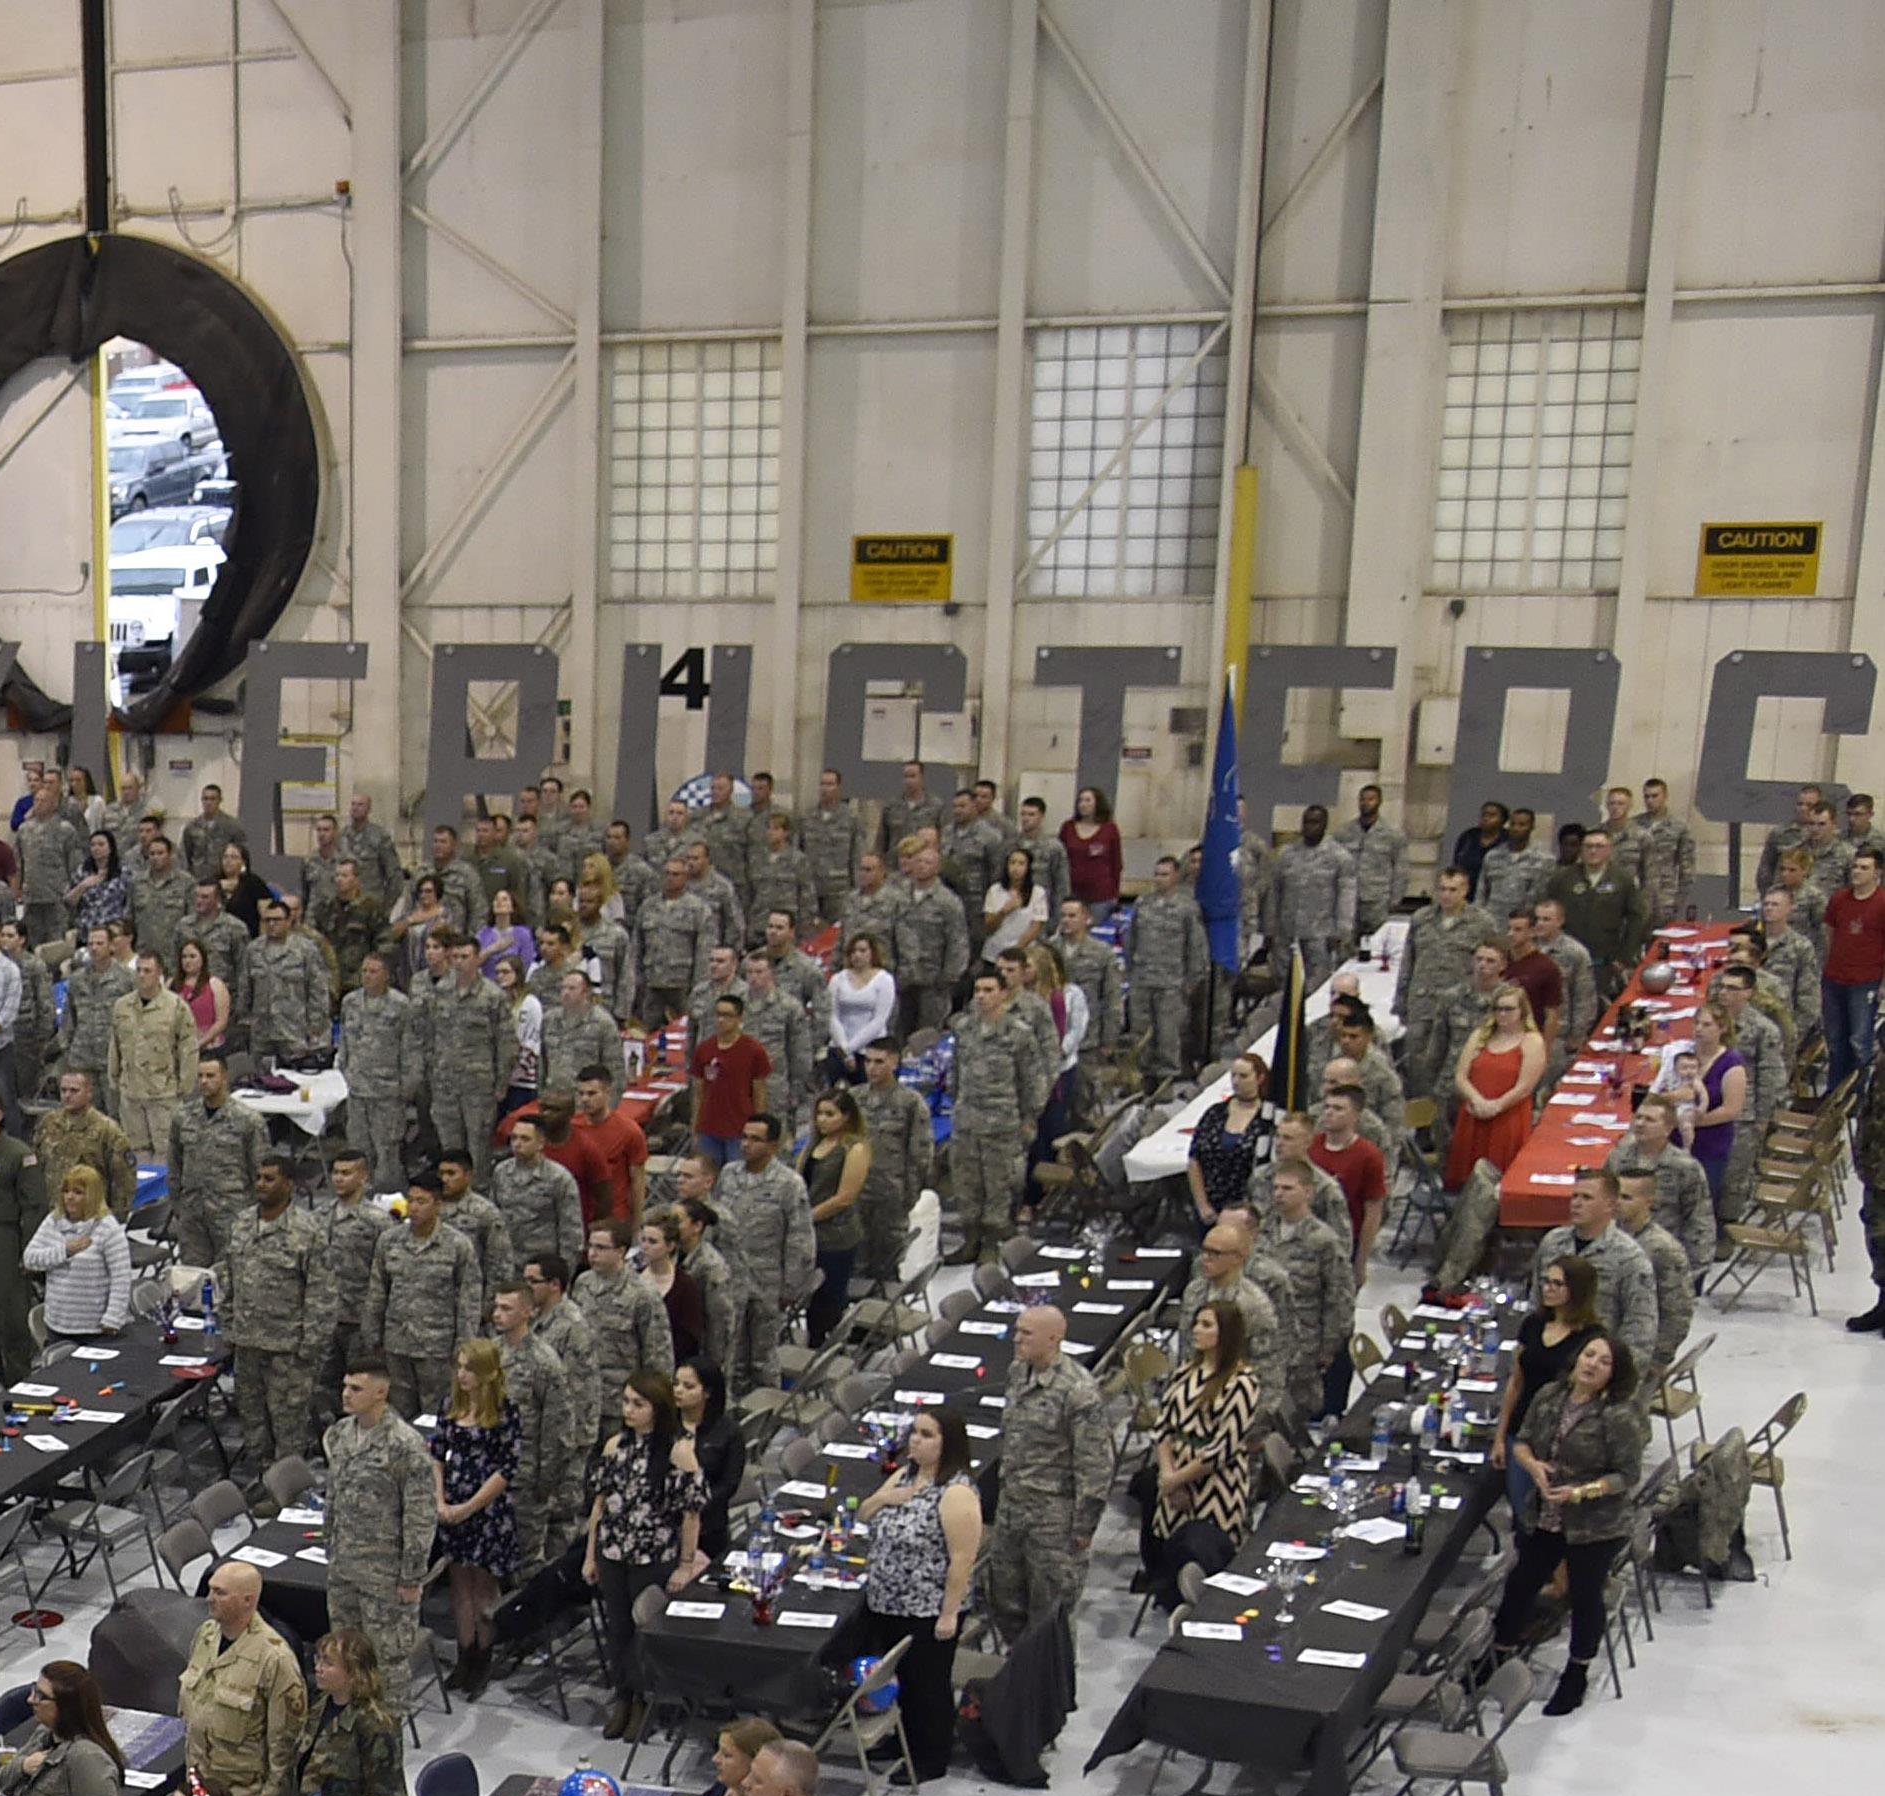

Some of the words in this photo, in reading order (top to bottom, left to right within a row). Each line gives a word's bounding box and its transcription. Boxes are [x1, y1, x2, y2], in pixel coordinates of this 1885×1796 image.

[1717, 531, 1804, 549] CAUTION
[865, 541, 940, 560] CAUTION
[659, 647, 710, 711] 4
